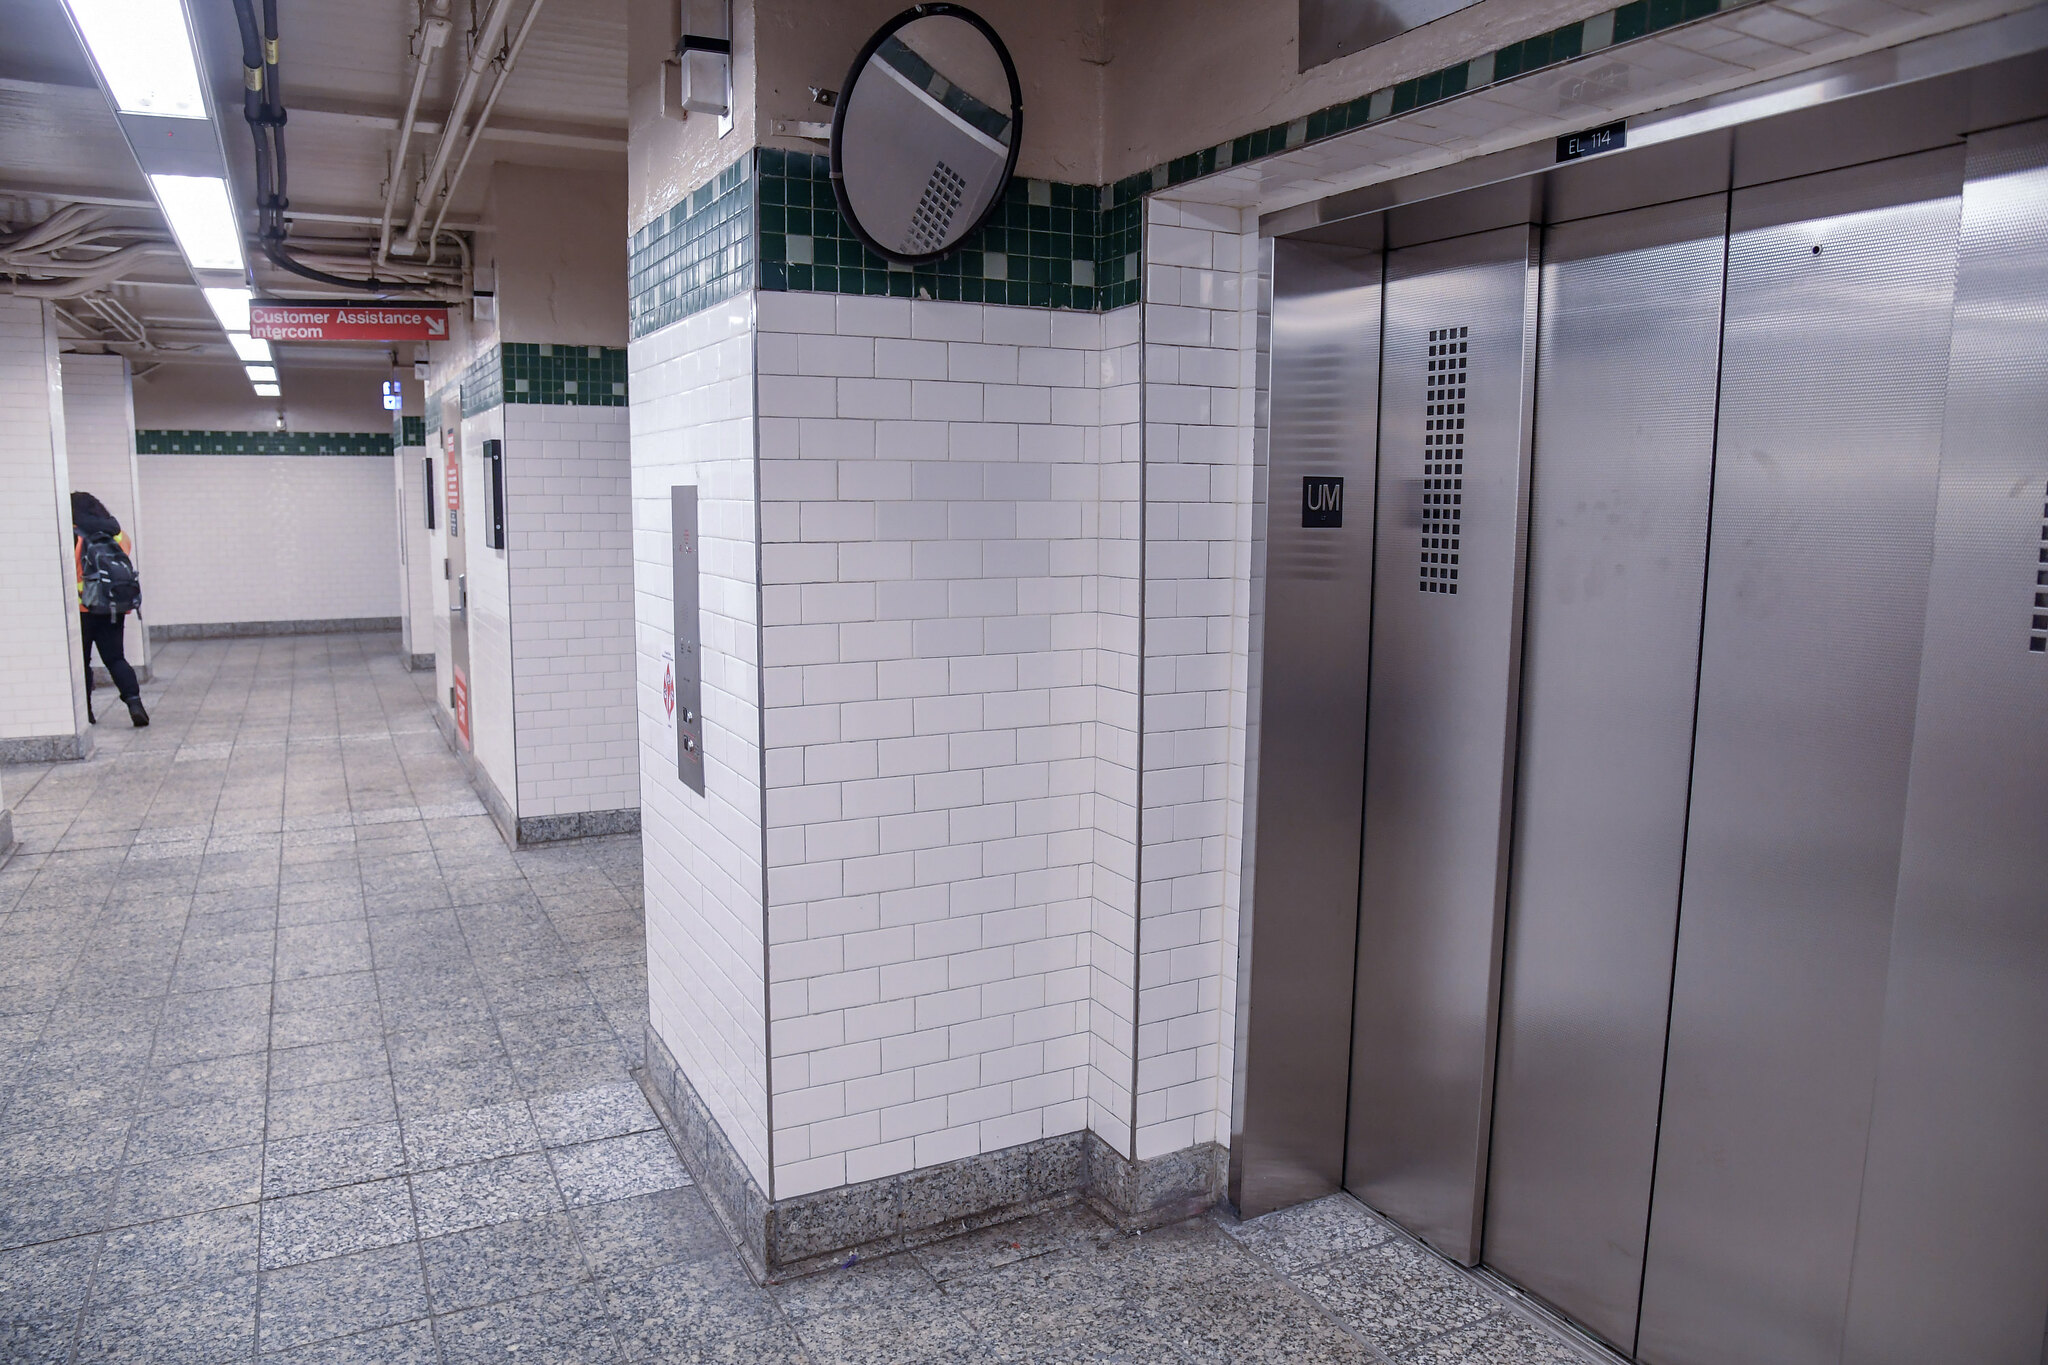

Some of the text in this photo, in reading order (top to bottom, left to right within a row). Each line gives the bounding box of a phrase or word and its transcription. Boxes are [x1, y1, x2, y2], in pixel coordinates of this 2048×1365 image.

[1568, 129, 1611, 155] EL 114
[251, 309, 422, 325] Customer Assistance
[252, 325, 323, 338] Intercom
[1308, 484, 1340, 511] UM
